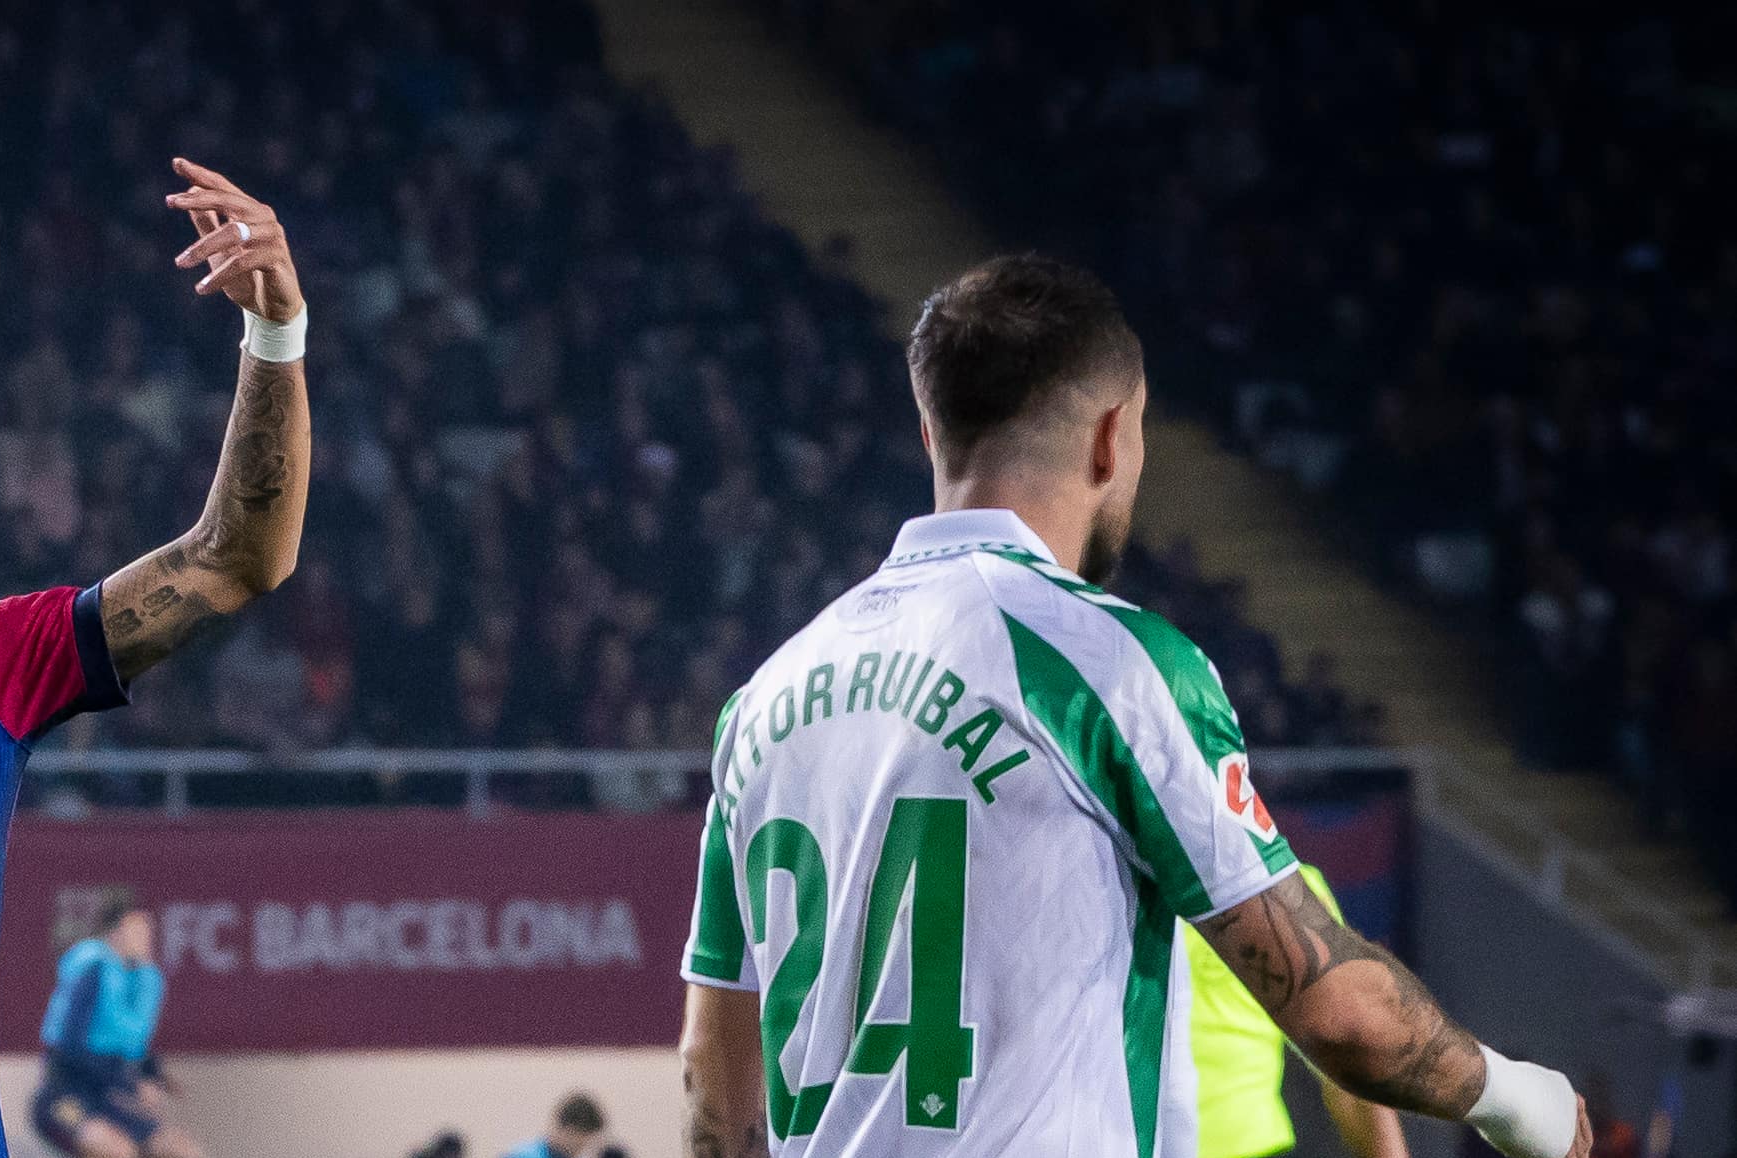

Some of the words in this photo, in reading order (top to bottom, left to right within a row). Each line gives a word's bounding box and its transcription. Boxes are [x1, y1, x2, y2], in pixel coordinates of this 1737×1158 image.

[845, 651, 1031, 805] RUIBAL
[163, 899, 239, 974] FC
[253, 898, 642, 970] BARCELONA
[745, 797, 975, 1143] 24
